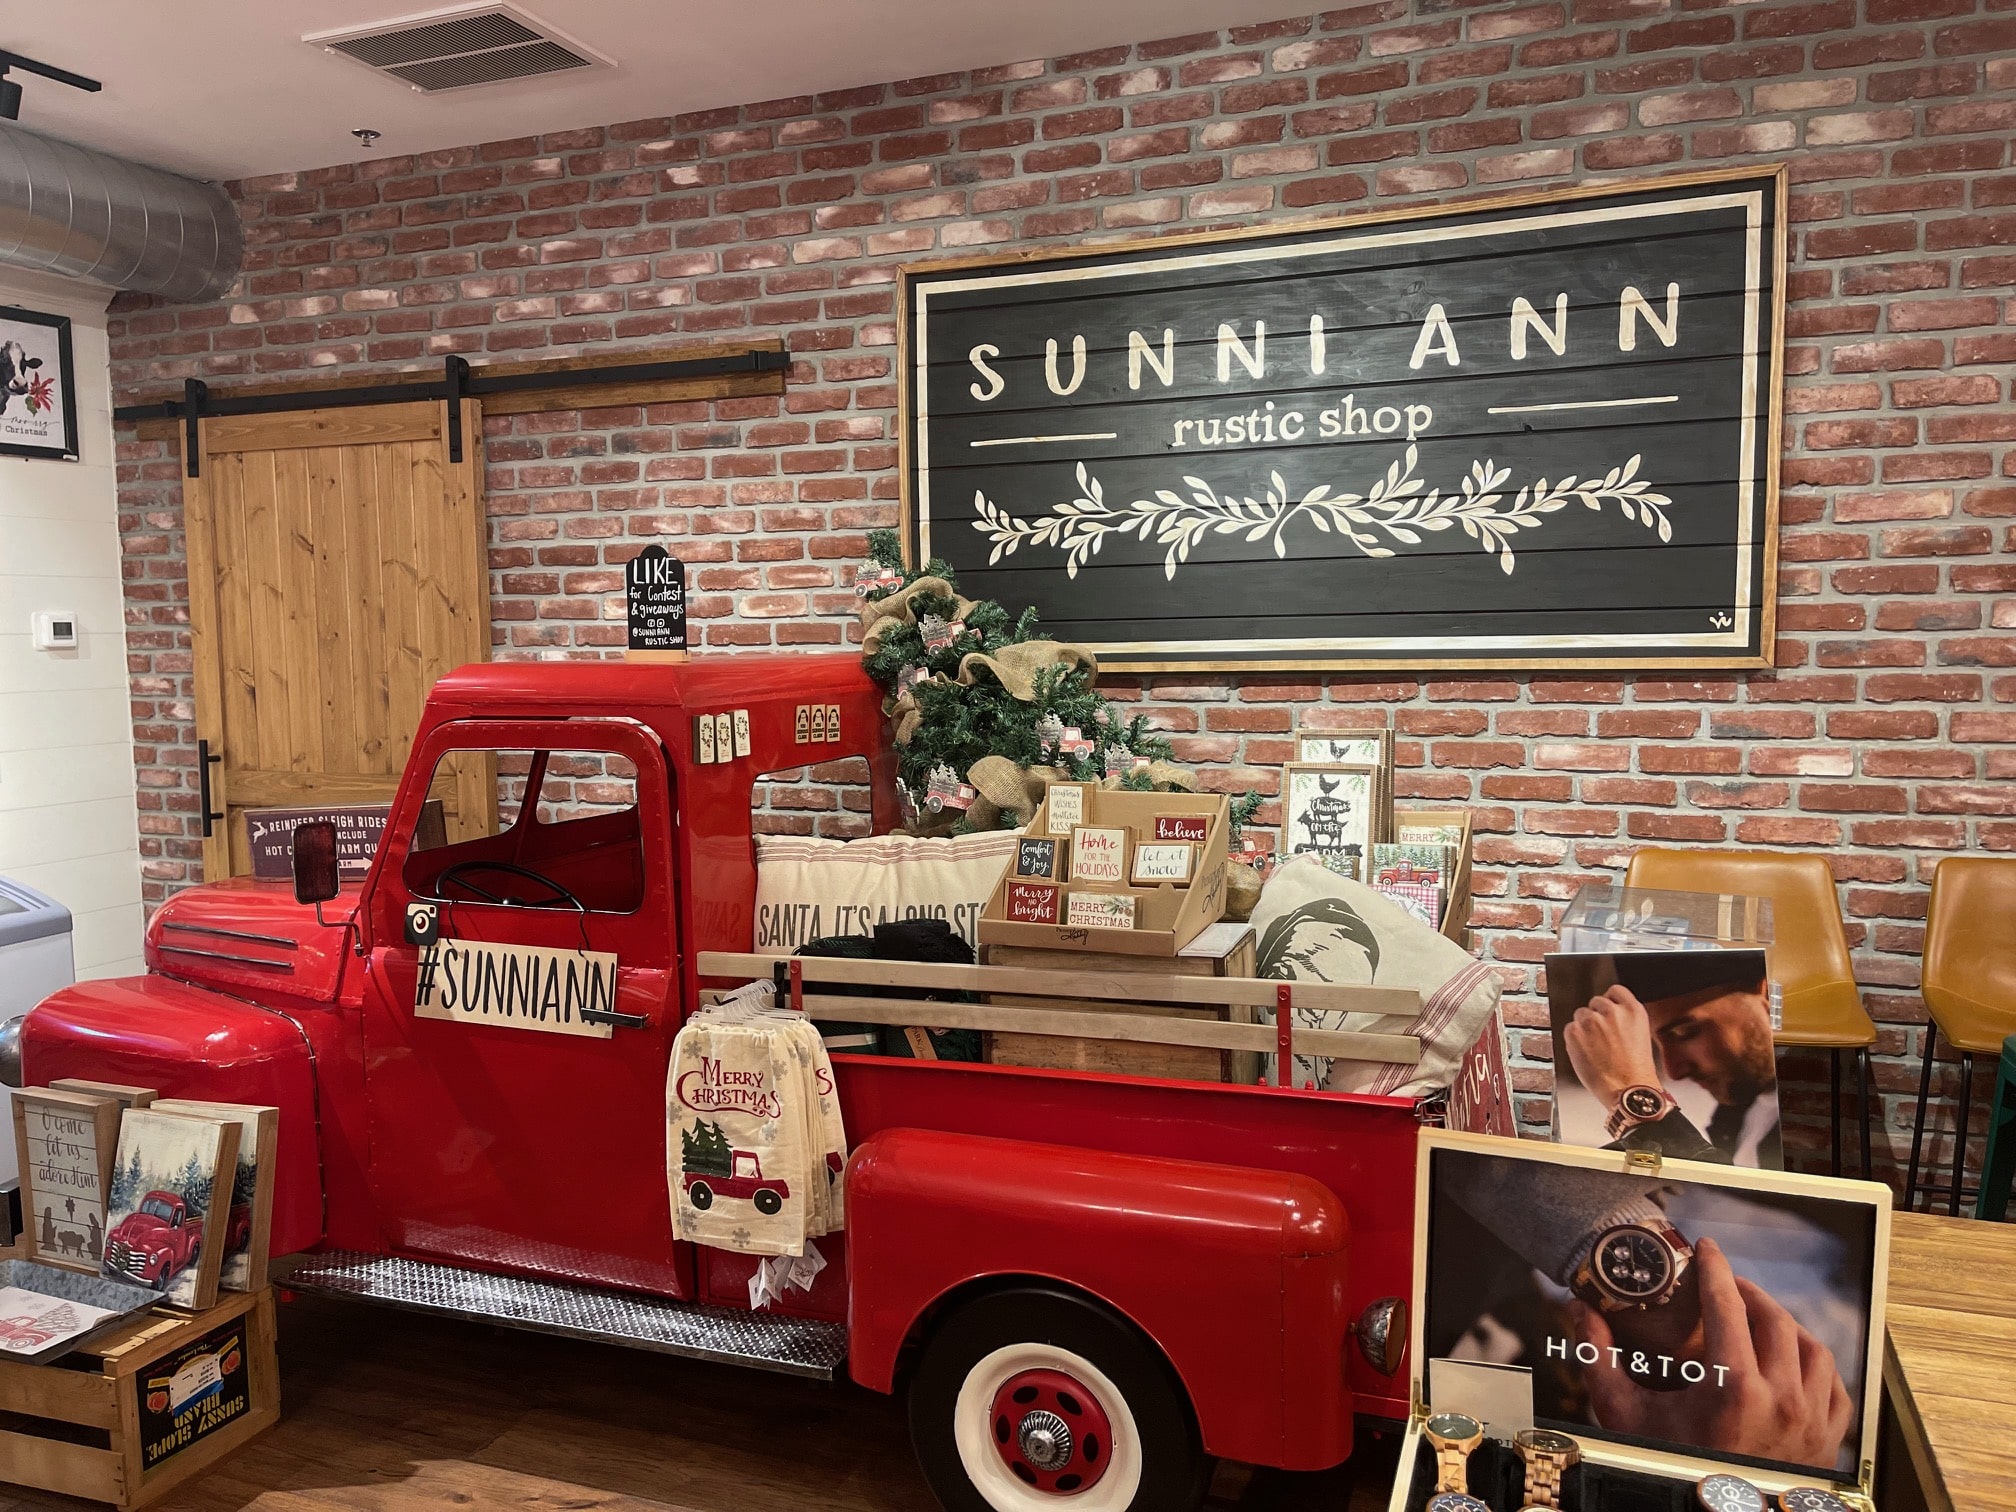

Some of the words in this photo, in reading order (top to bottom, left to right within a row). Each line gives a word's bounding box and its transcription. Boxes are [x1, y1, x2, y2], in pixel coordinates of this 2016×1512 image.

[1173, 401, 1305, 448] rustic
[1318, 393, 1434, 441] shop
[5, 425, 48, 437] Christmas
[633, 556, 678, 585] LIKE
[629, 586, 642, 599] for
[648, 585, 682, 601] Contest
[631, 602, 639, 616] &
[639, 603, 684, 619] giveaways
[645, 637, 668, 645] RUSTIC
[670, 636, 684, 644] SHOP
[358, 815, 387, 828] RIDES
[1050, 821, 1072, 831] KISS
[1156, 818, 1205, 840] believe
[337, 830, 367, 839] NCLUDE
[1080, 831, 1118, 850] Home
[1401, 833, 1434, 842] MERRY
[265, 846, 283, 856] HOT
[337, 843, 360, 854] ARM
[1021, 841, 1053, 858] Comfort
[1084, 852, 1098, 861] FOR
[1100, 852, 1111, 862] THE
[1142, 847, 1163, 862] let
[1167, 848, 1186, 862] it
[1075, 862, 1120, 877] HOLIDAYS
[1141, 864, 1181, 877] snow
[1013, 886, 1054, 903] Merry
[1012, 899, 1054, 922] bright
[1070, 901, 1106, 914] MERRY
[1069, 914, 1131, 928] CHRISTMAS
[415, 945, 616, 1026] #SUNNIANN
[54, 1116, 87, 1136] come
[46, 1133, 62, 1157] let
[66, 1143, 88, 1160] us
[39, 1158, 69, 1185] adore
[71, 1166, 97, 1189] Him
[1545, 1335, 1732, 1388] HOT&TOT
[197, 1395, 244, 1435] SUNNY
[145, 1424, 192, 1461] SLOPE
